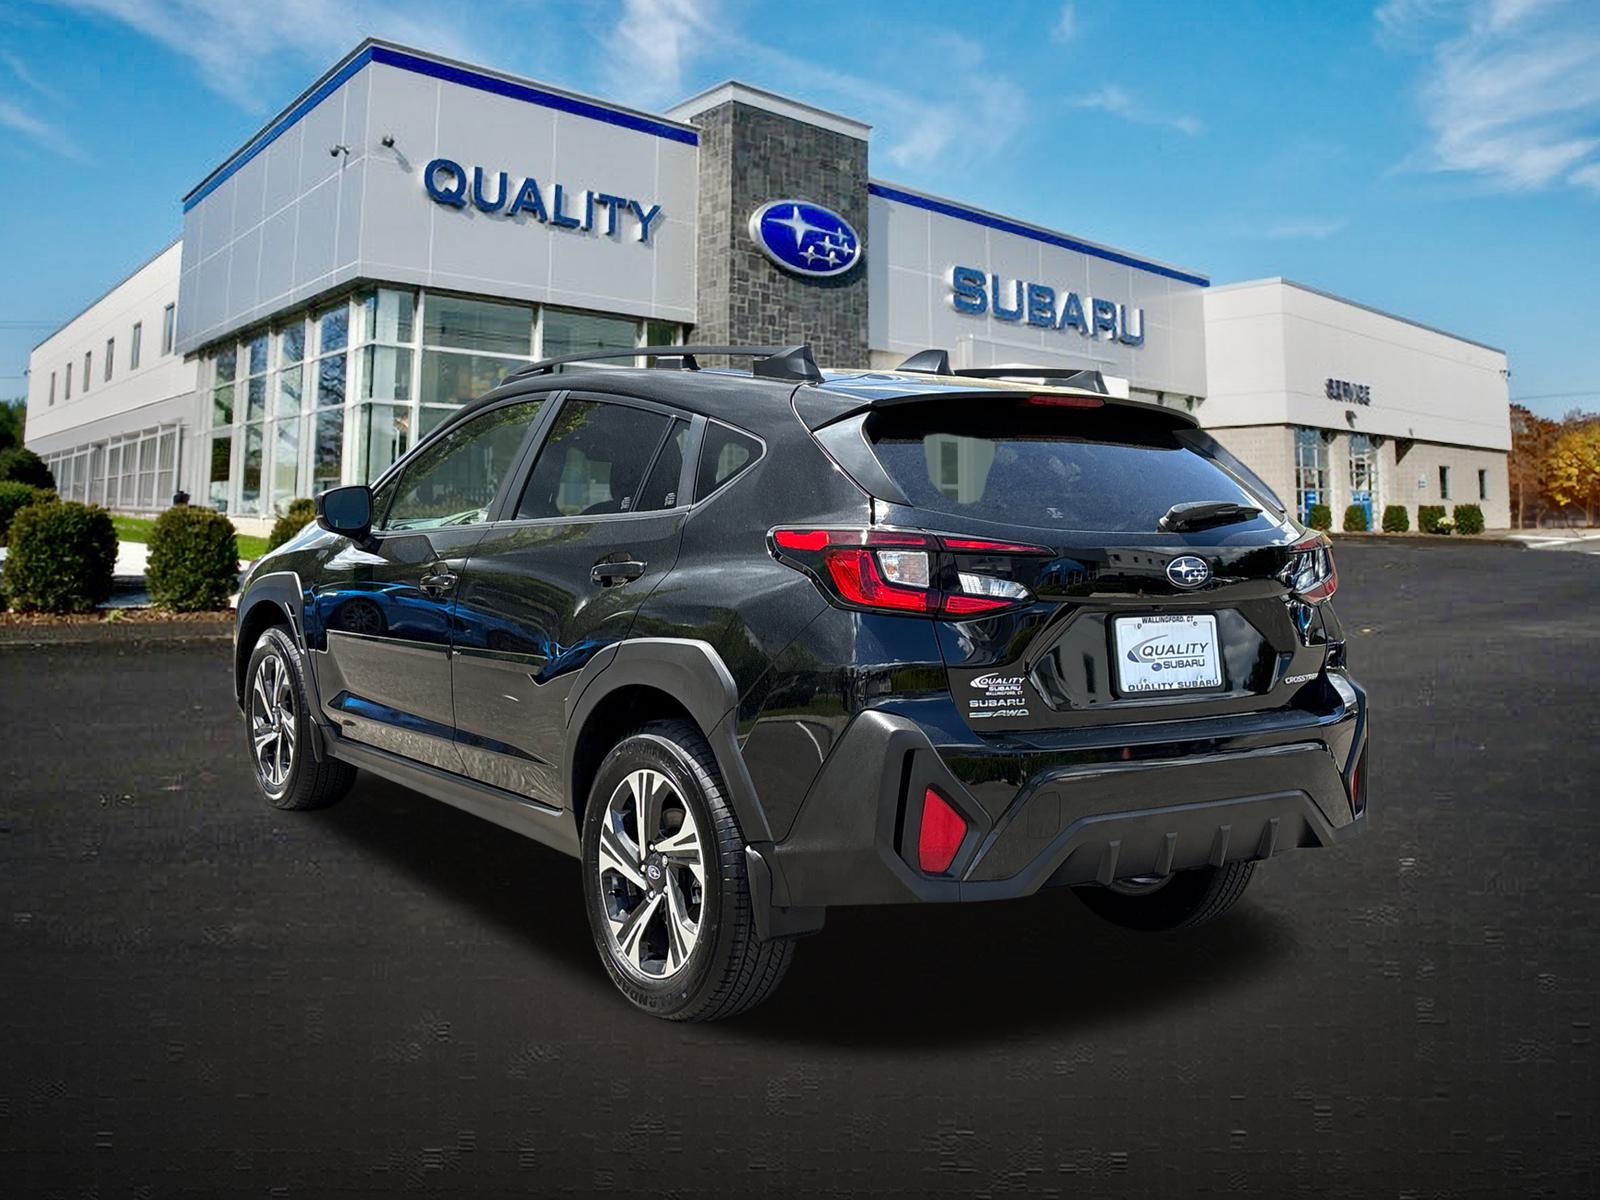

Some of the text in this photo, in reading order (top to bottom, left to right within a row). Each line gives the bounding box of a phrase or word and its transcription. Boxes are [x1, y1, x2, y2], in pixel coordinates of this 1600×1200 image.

[424, 158, 661, 242] QUALITY
[949, 265, 1144, 346] SUBARU
[1142, 642, 1208, 656] QUALITY
[1163, 659, 1205, 669] SUBARU
[1128, 679, 1219, 691] QUALITY SUBARU
[969, 698, 1025, 707] SUBARU
